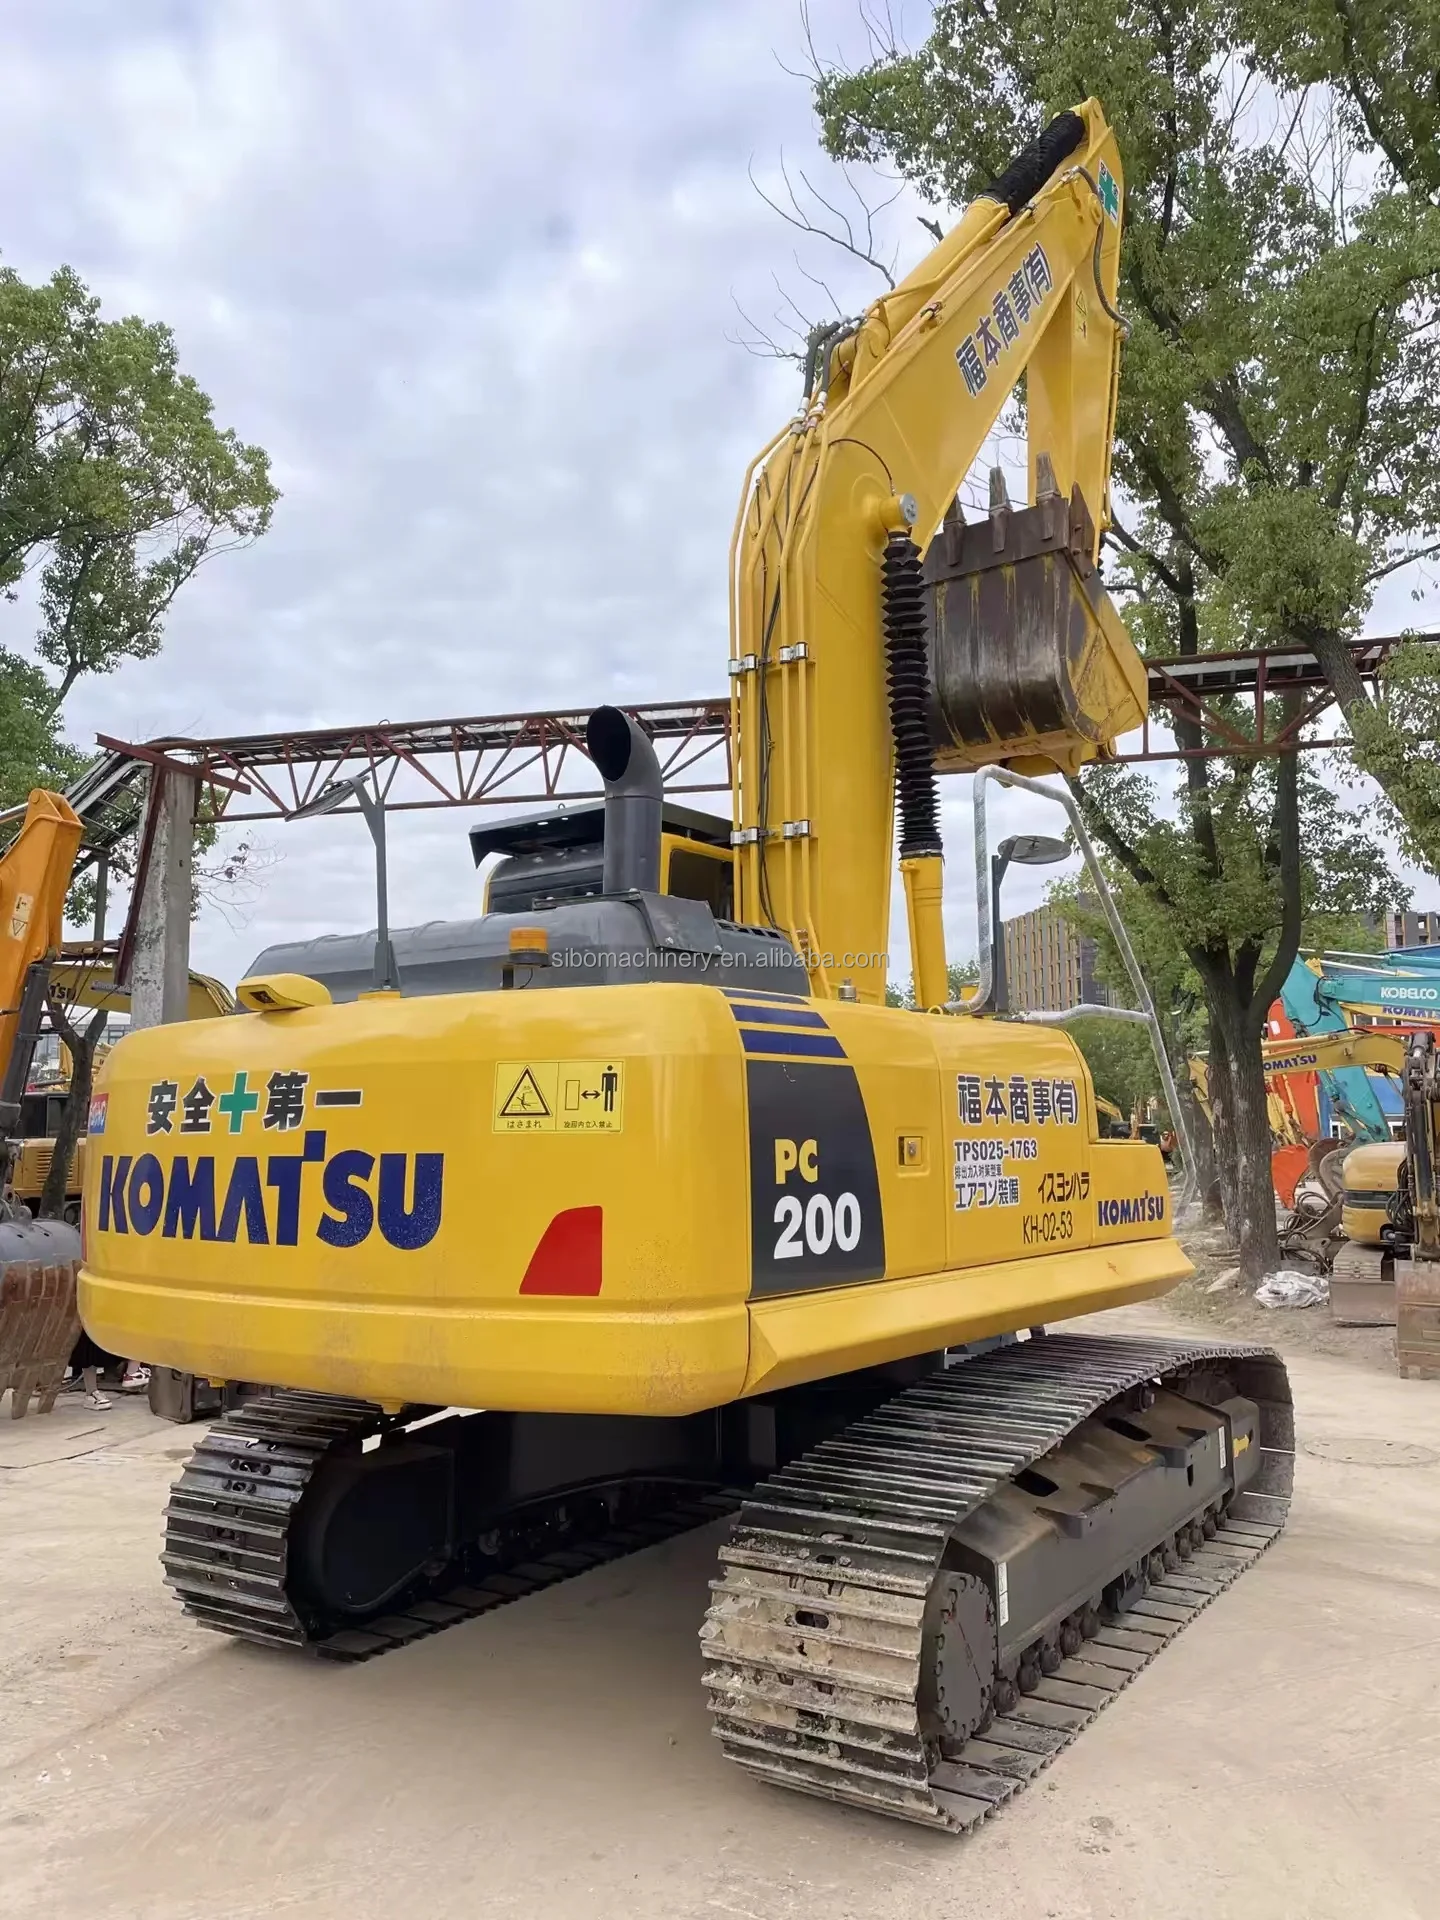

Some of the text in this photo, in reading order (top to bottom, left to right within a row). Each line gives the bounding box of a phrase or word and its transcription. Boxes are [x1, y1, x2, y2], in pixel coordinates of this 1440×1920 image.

[1380, 986, 1438, 1000] KOBELCO
[1263, 1054, 1317, 1071] OMATSU
[774, 1138, 819, 1185] PC
[98, 1130, 444, 1251] KOMATSU
[1097, 1189, 1164, 1227] KOMATSU
[773, 1191, 862, 1260] 200
[1022, 1210, 1074, 1245] KH-02-53
